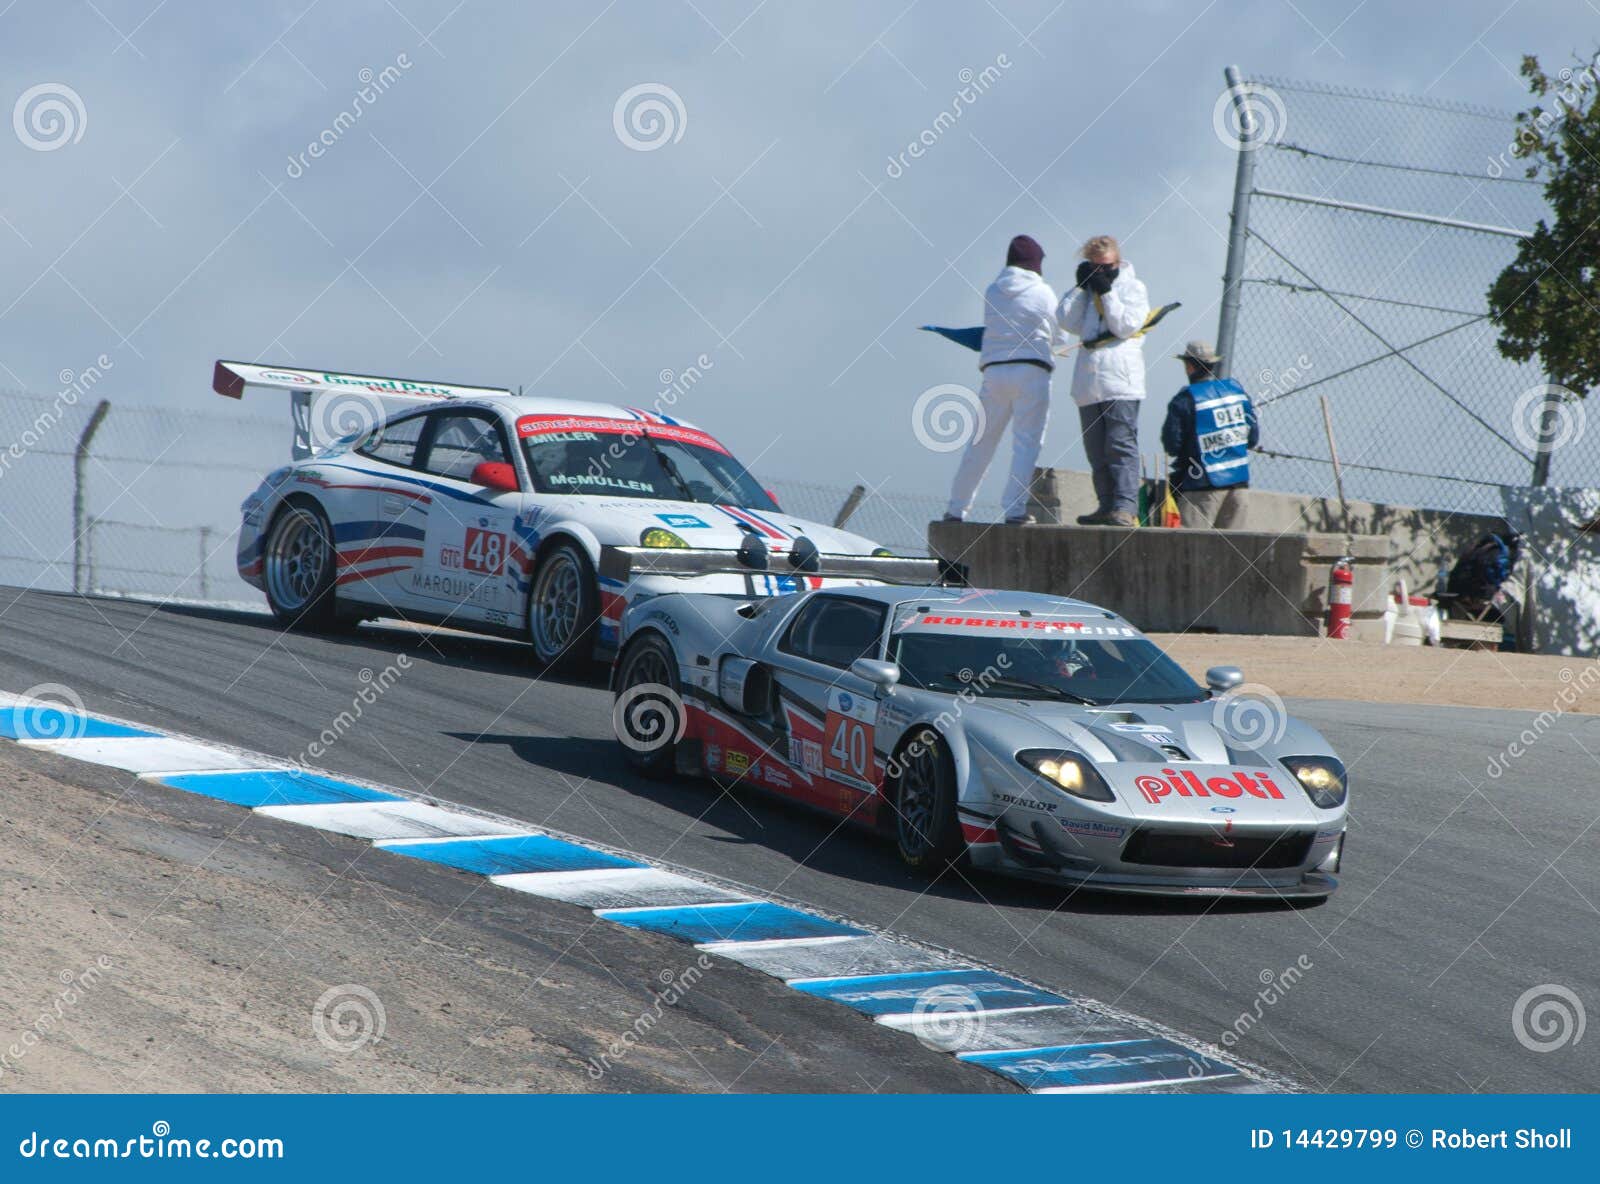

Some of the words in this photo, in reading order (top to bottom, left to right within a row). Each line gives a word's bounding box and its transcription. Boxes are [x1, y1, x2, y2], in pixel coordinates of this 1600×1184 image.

[323, 373, 398, 391] Grand
[400, 380, 452, 396] Prix
[1216, 407, 1243, 424] 914
[529, 431, 598, 445] MILLER
[550, 474, 654, 493] McMULLEN
[441, 548, 462, 568] GTC
[467, 532, 501, 572] 48
[921, 616, 1085, 630] ROBERTSON
[831, 720, 867, 777] 40
[1135, 768, 1286, 804] piloti
[1001, 794, 1057, 812] DUNLOP
[1061, 818, 1090, 830] David
